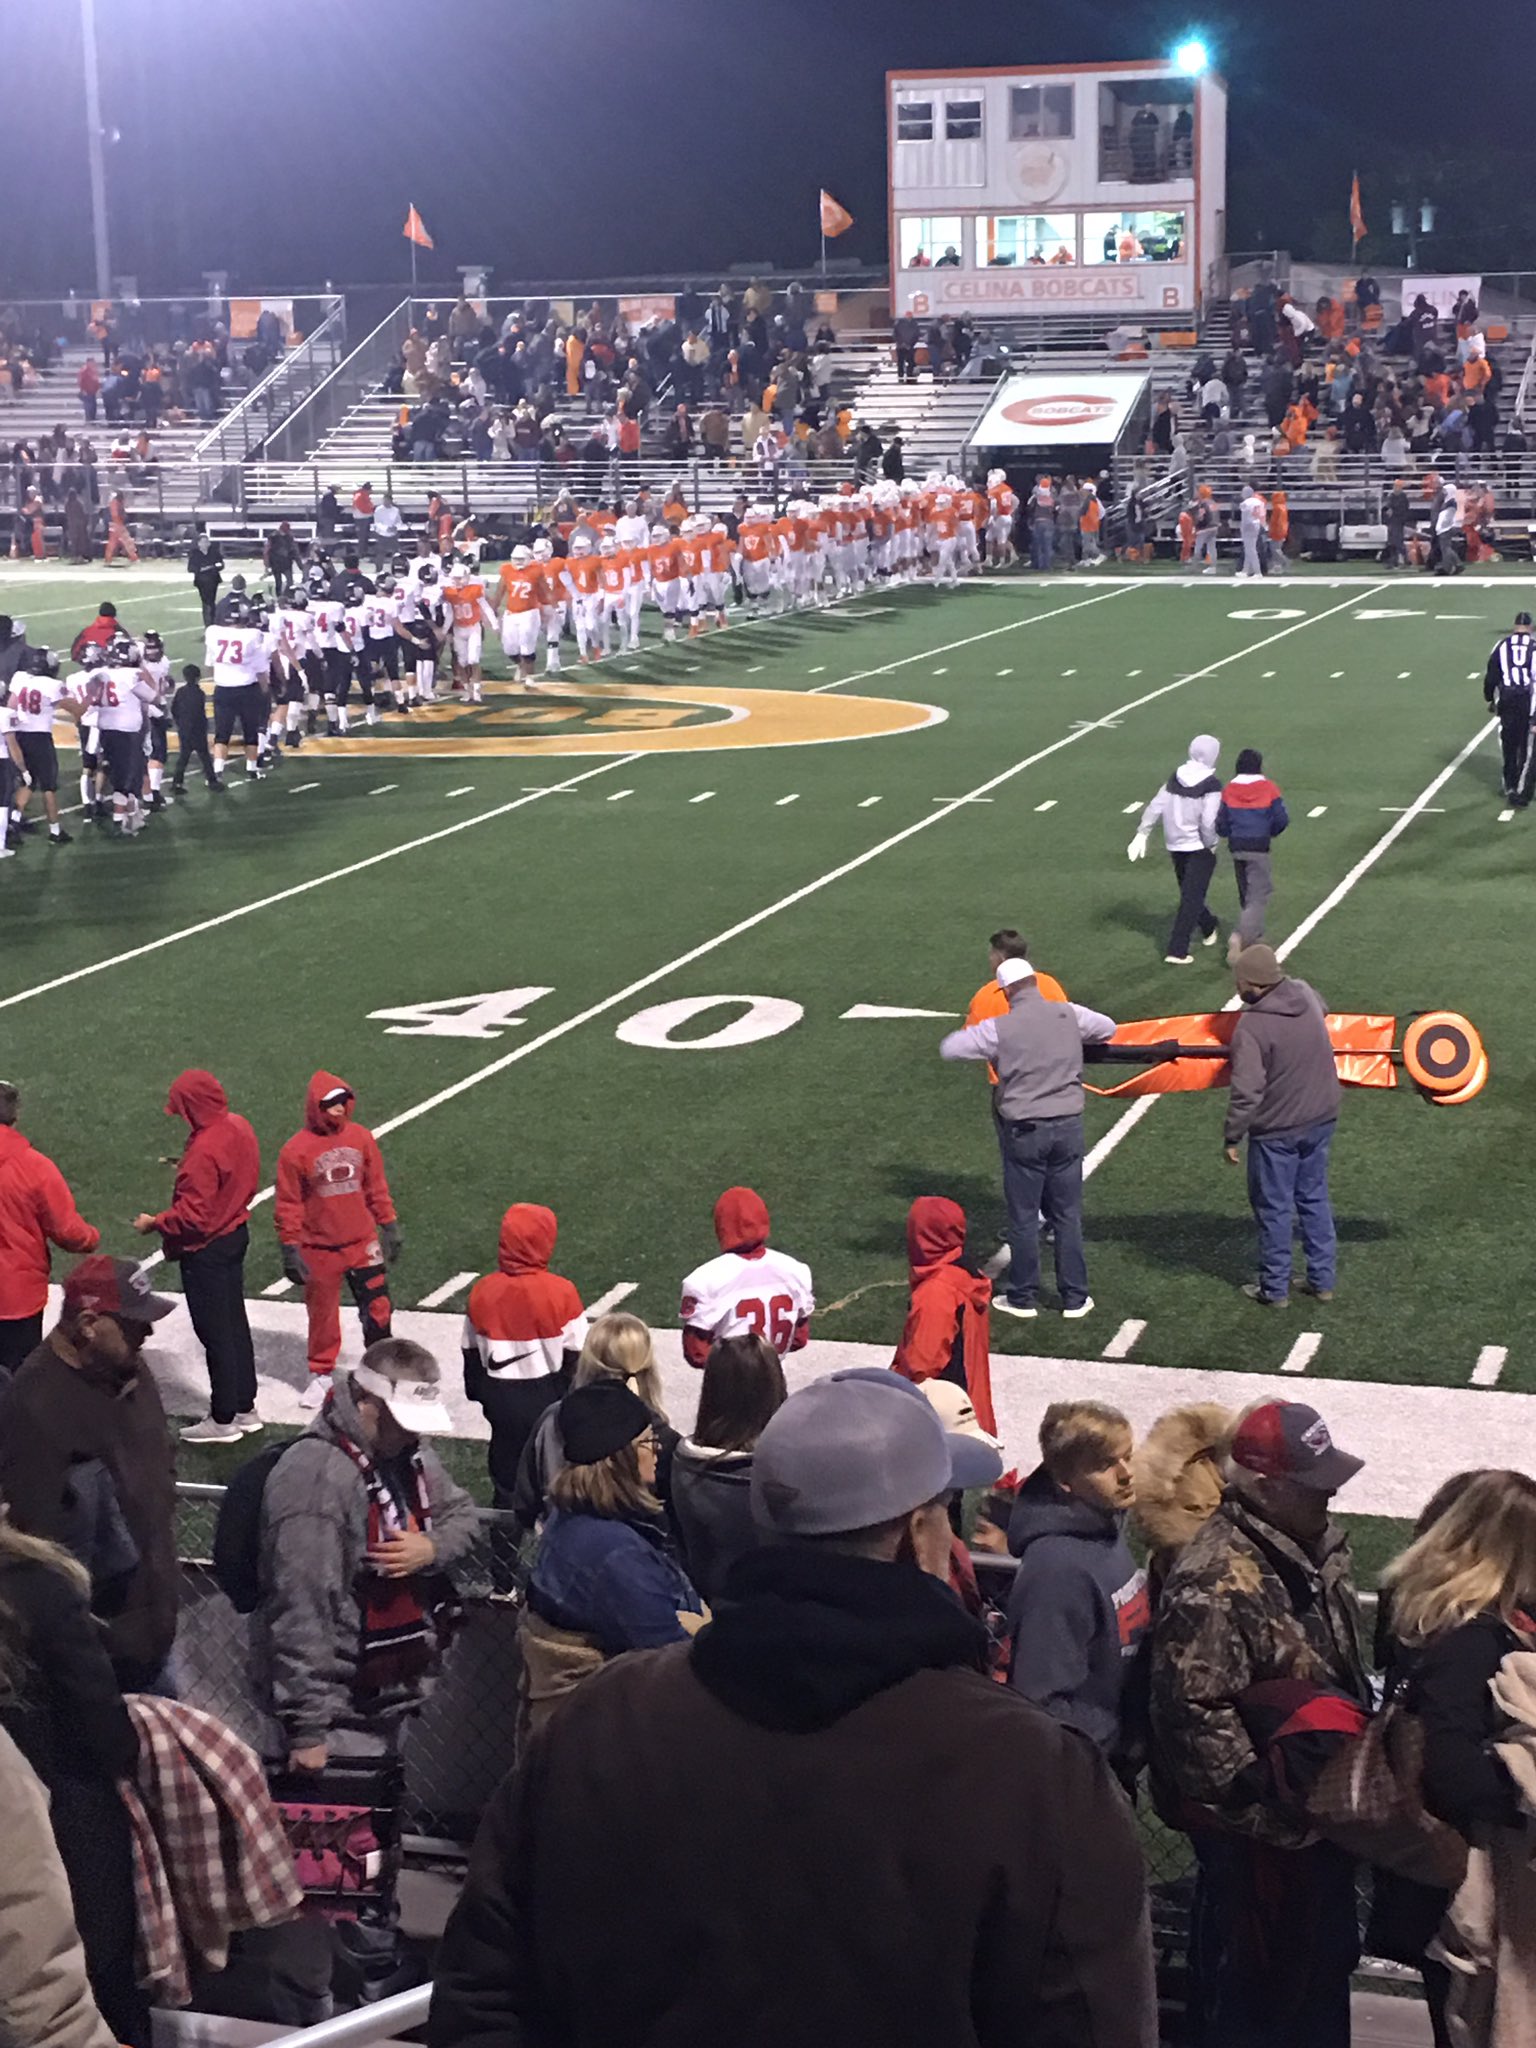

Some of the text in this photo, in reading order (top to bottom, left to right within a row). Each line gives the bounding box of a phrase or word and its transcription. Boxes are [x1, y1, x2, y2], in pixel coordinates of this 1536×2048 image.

[944, 278, 1134, 298] CELINA BOBCATS
[1163, 287, 1180, 307] B
[913, 295, 929, 314] B
[1031, 405, 1114, 416] BOBCATS
[511, 581, 532, 599] 72
[216, 640, 243, 664] 73
[1511, 645, 1528, 666] U
[18, 687, 42, 715] 48
[735, 1294, 793, 1355] 36
